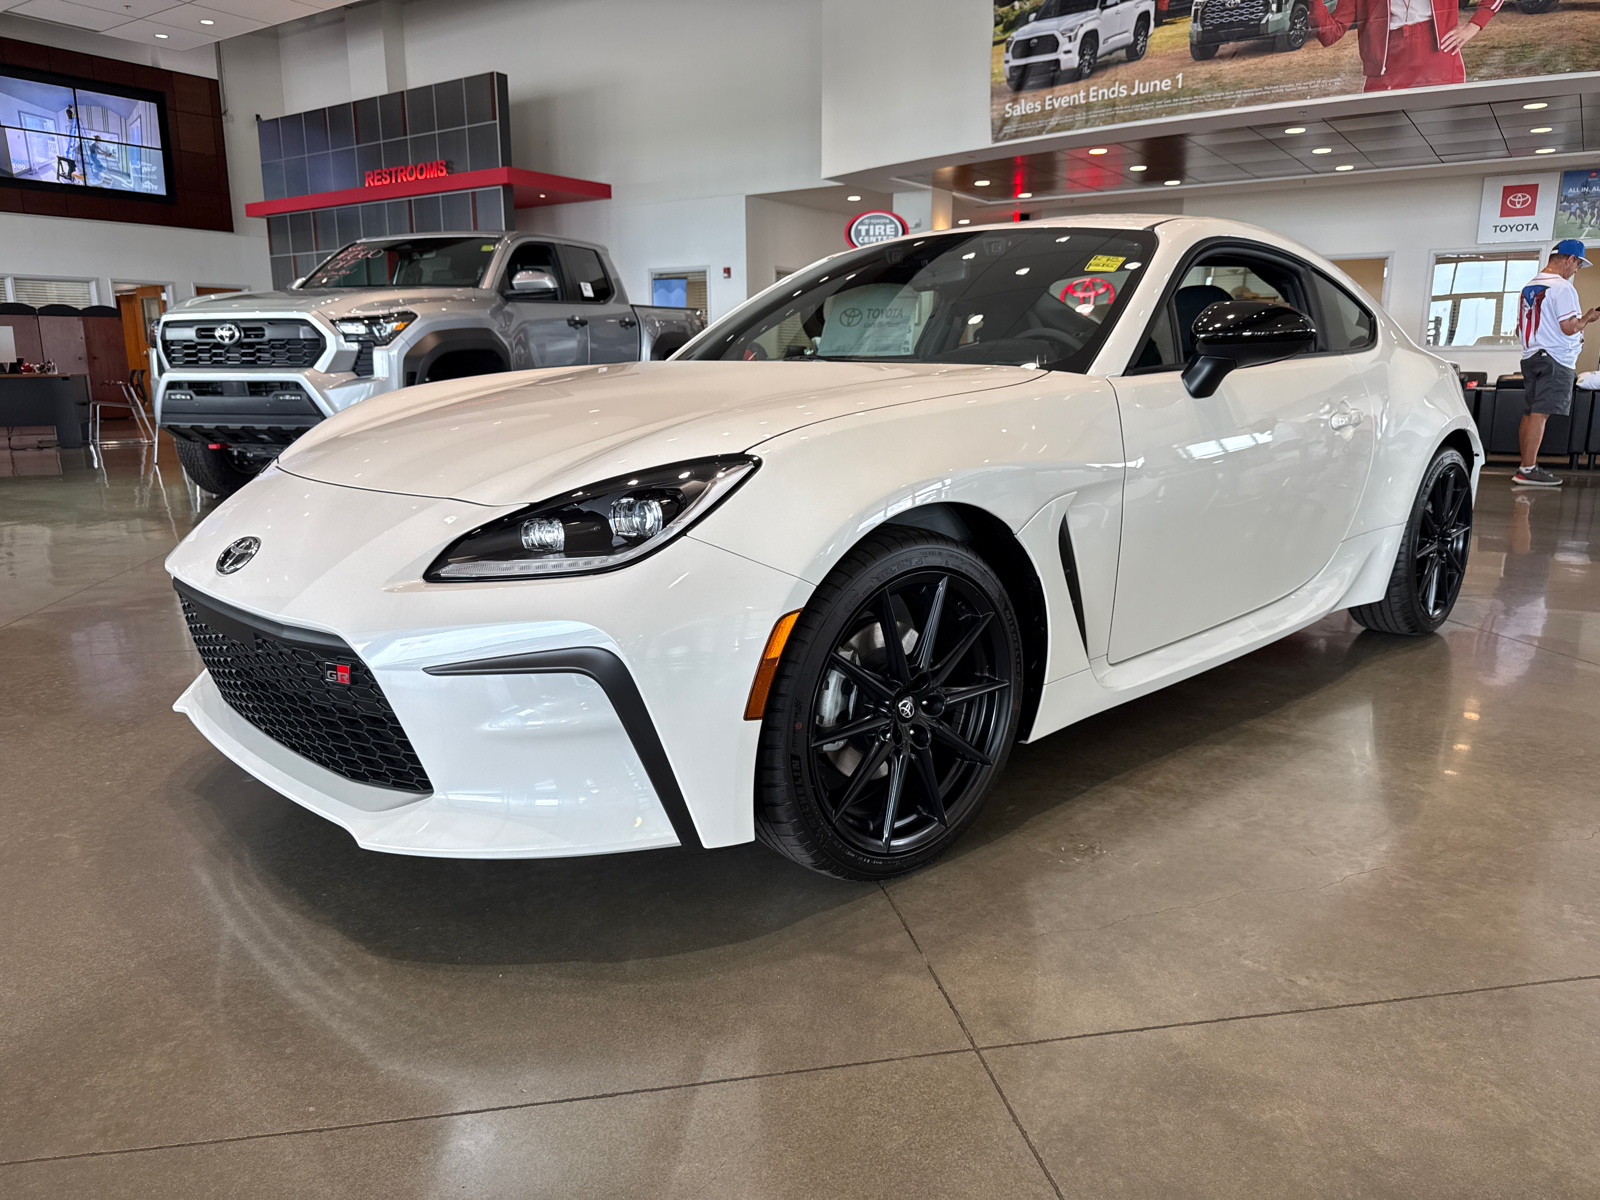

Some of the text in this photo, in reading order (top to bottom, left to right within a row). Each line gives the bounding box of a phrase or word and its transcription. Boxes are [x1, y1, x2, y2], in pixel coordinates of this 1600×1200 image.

[1004, 100, 1041, 118] Sales
[1045, 90, 1086, 111] Event
[1089, 82, 1127, 102] Ends
[1131, 78, 1172, 96] June
[1176, 73, 1183, 88] 1
[364, 159, 447, 187] RESTROOMS
[858, 224, 895, 236] TIRE
[1492, 222, 1539, 233] TOYOTA
[867, 308, 903, 319] TOYOTA
[326, 670, 348, 682] GR
